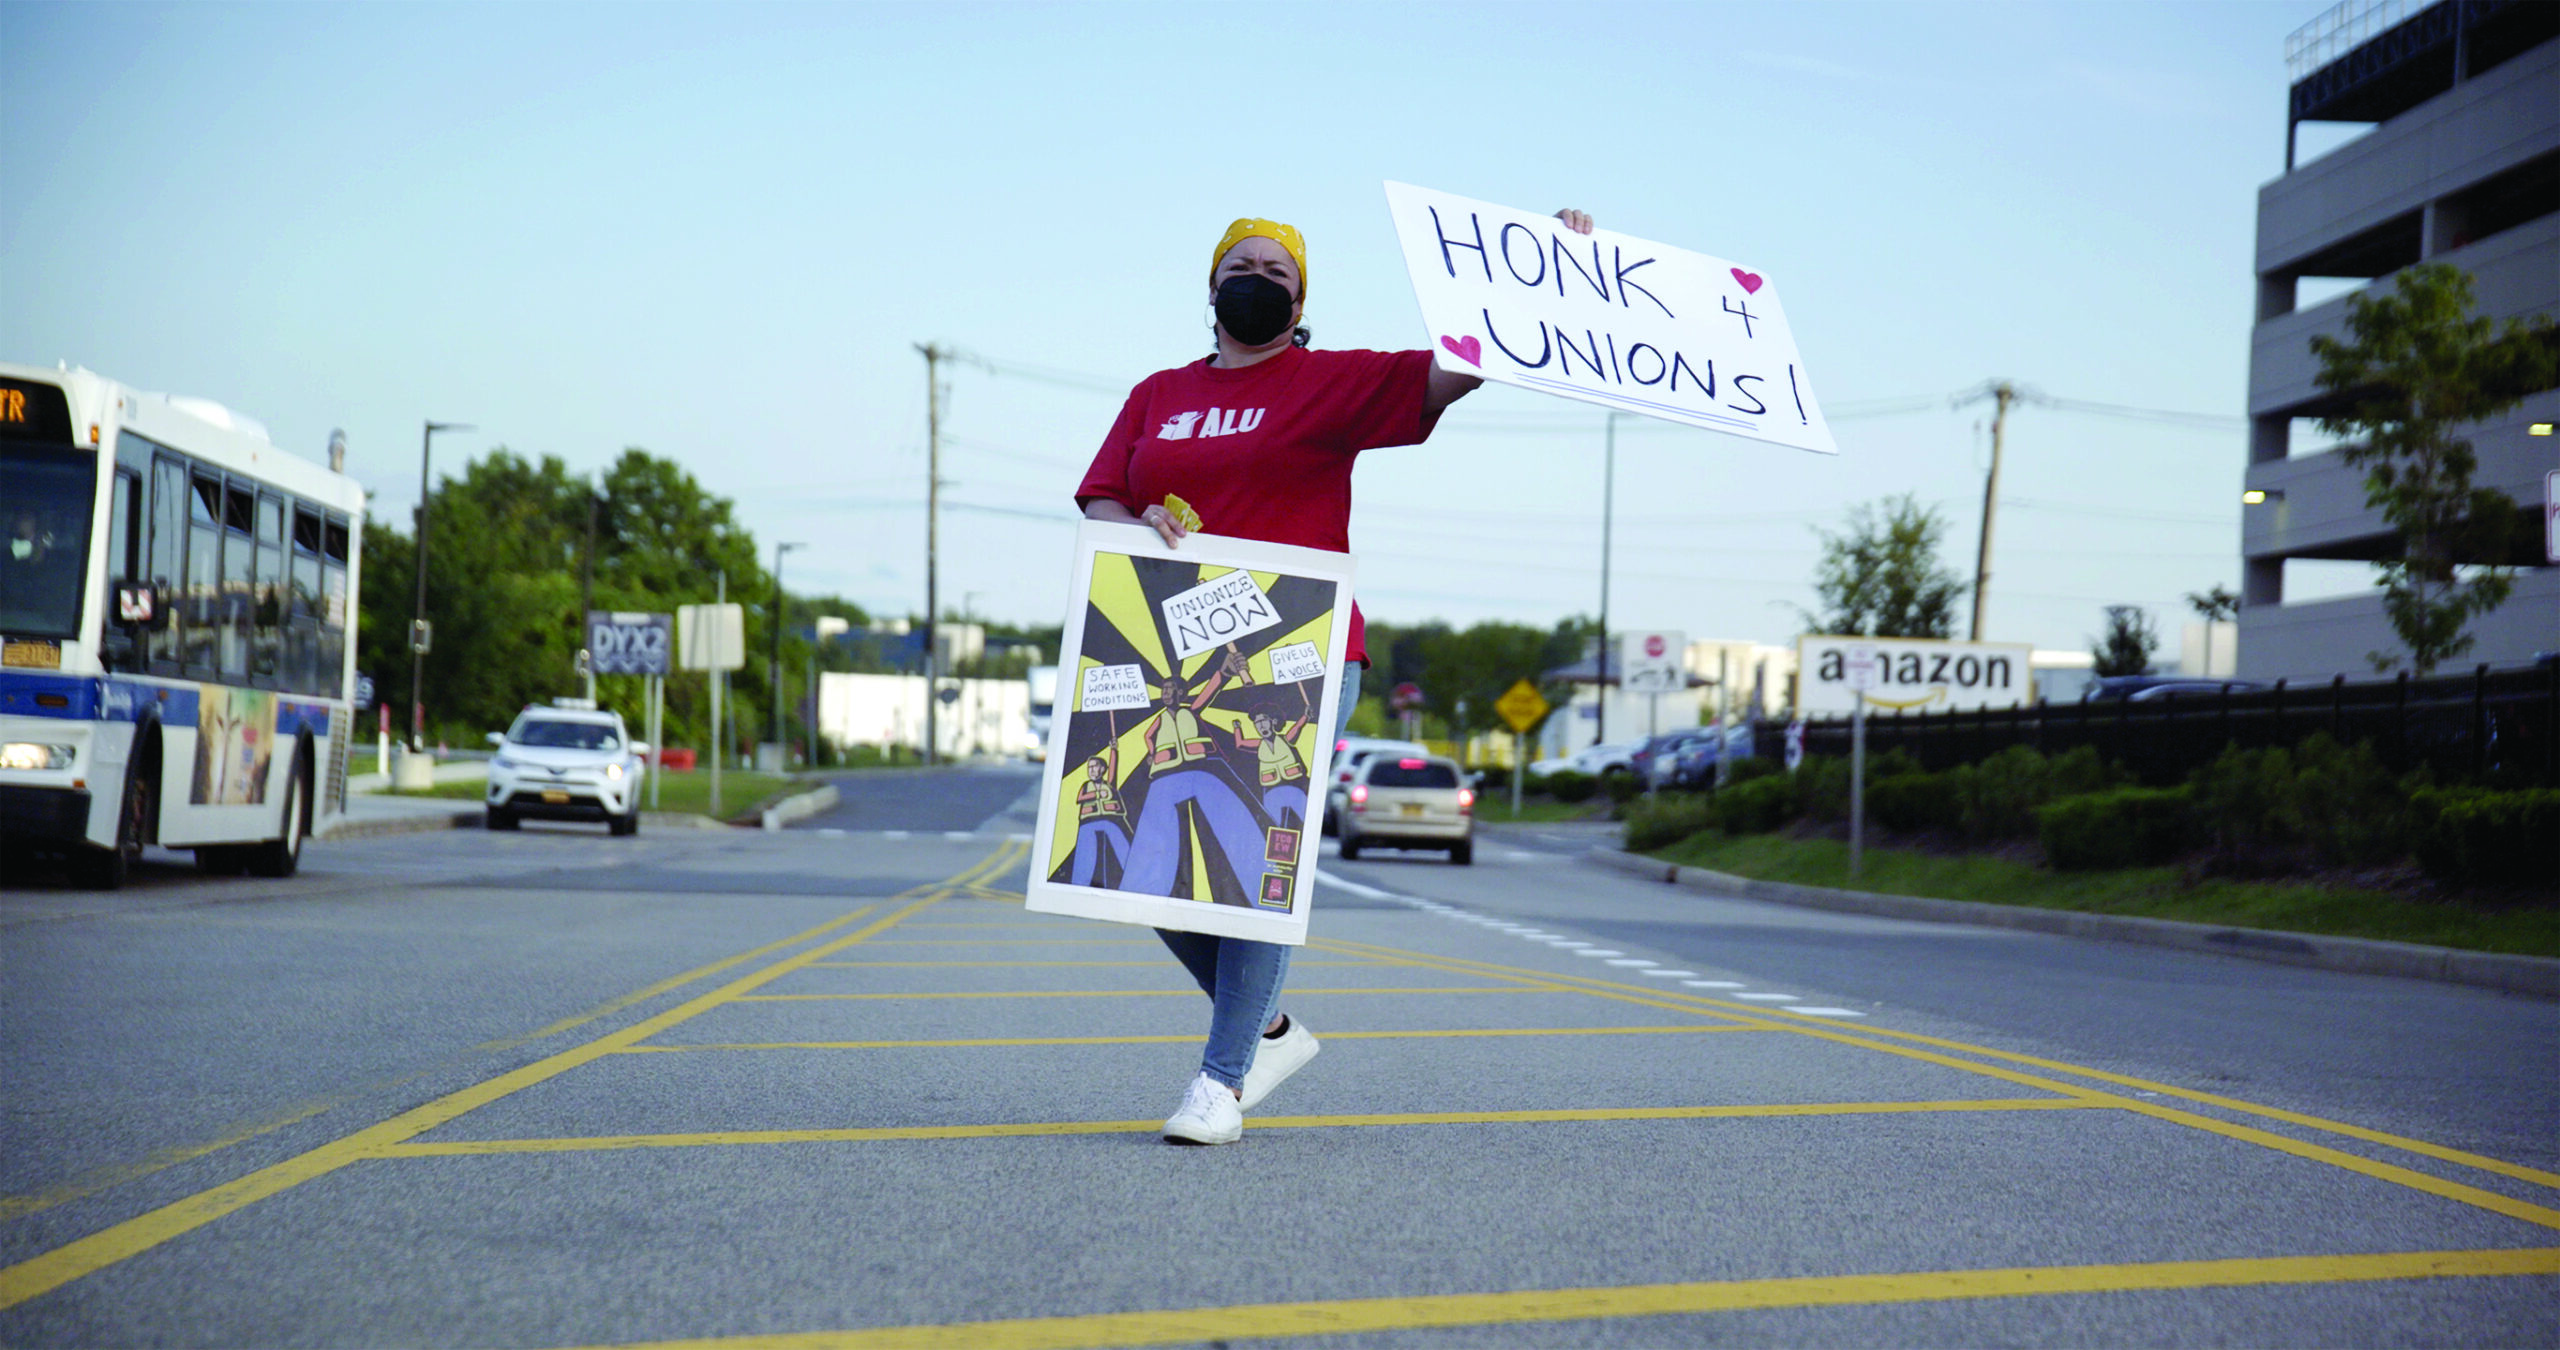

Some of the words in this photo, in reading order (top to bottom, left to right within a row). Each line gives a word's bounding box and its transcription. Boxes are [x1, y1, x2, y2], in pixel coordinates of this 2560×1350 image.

[1428, 204, 1675, 319] HONK
[1722, 294, 1760, 339] 4
[1198, 406, 1266, 438] ALU
[1170, 575, 1254, 620] UNIONIZE
[1178, 593, 1270, 651] NOW
[593, 623, 667, 659] DYX2
[1272, 649, 1300, 665] GIVE
[1300, 646, 1315, 658] US
[1089, 666, 1137, 682] SAFE
[1278, 669, 1287, 680] A
[1288, 660, 1322, 677] VOICE
[1083, 691, 1147, 708] CONDITIONS
[1088, 680, 1139, 693] WORKING
